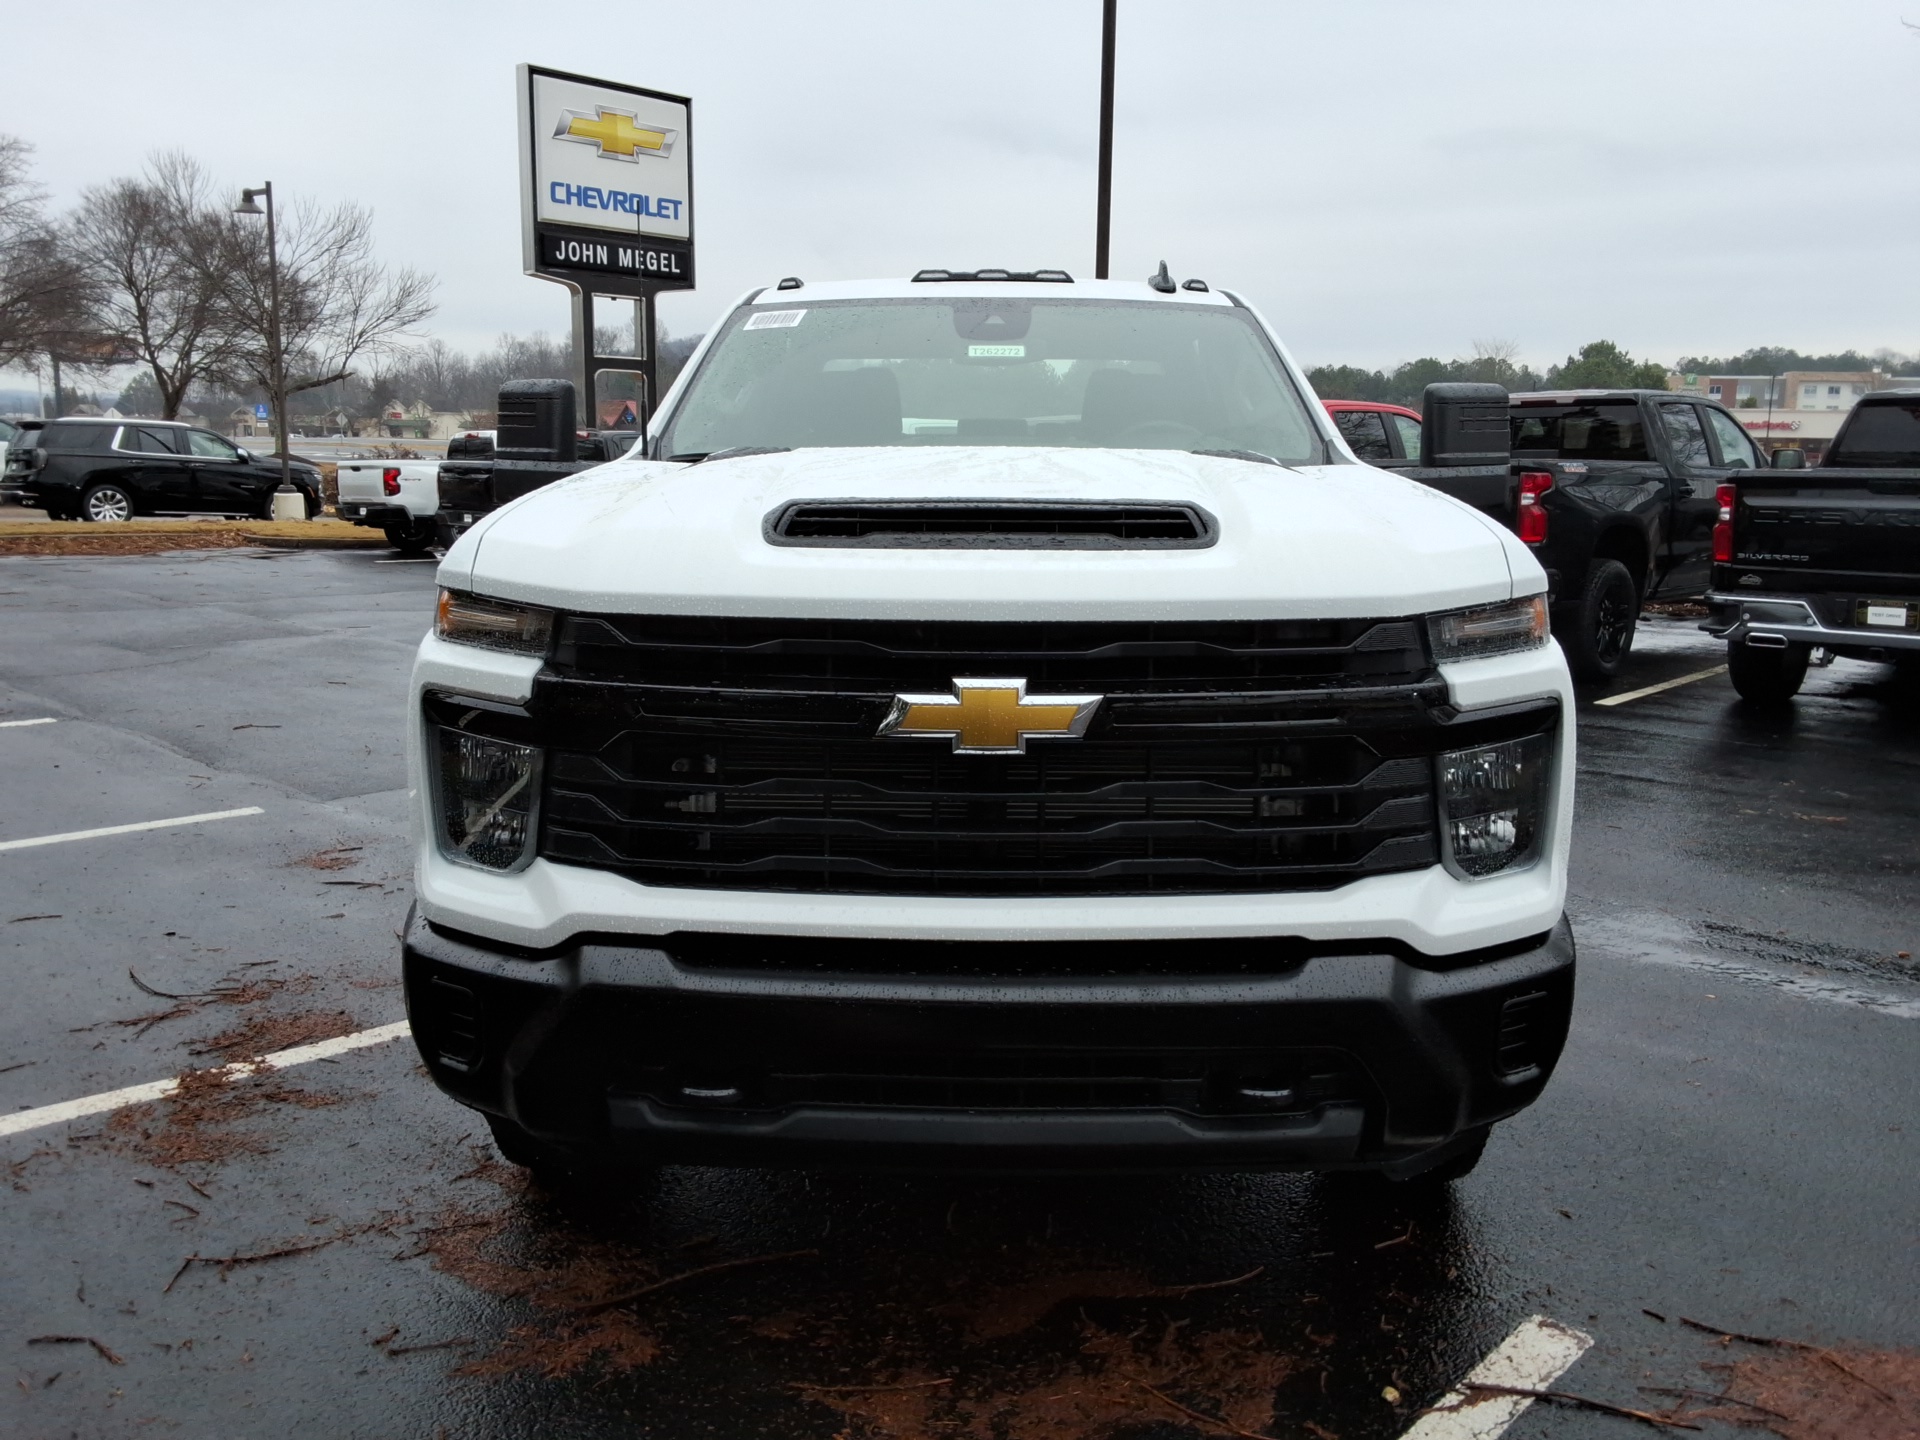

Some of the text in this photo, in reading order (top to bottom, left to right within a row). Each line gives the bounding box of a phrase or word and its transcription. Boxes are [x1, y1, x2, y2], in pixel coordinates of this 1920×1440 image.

[550, 181, 682, 220] CHEVROLET
[556, 240, 681, 274] JOHN MEGEL
[971, 347, 1021, 356] T262272
[1736, 552, 1810, 562] SILVERADO
